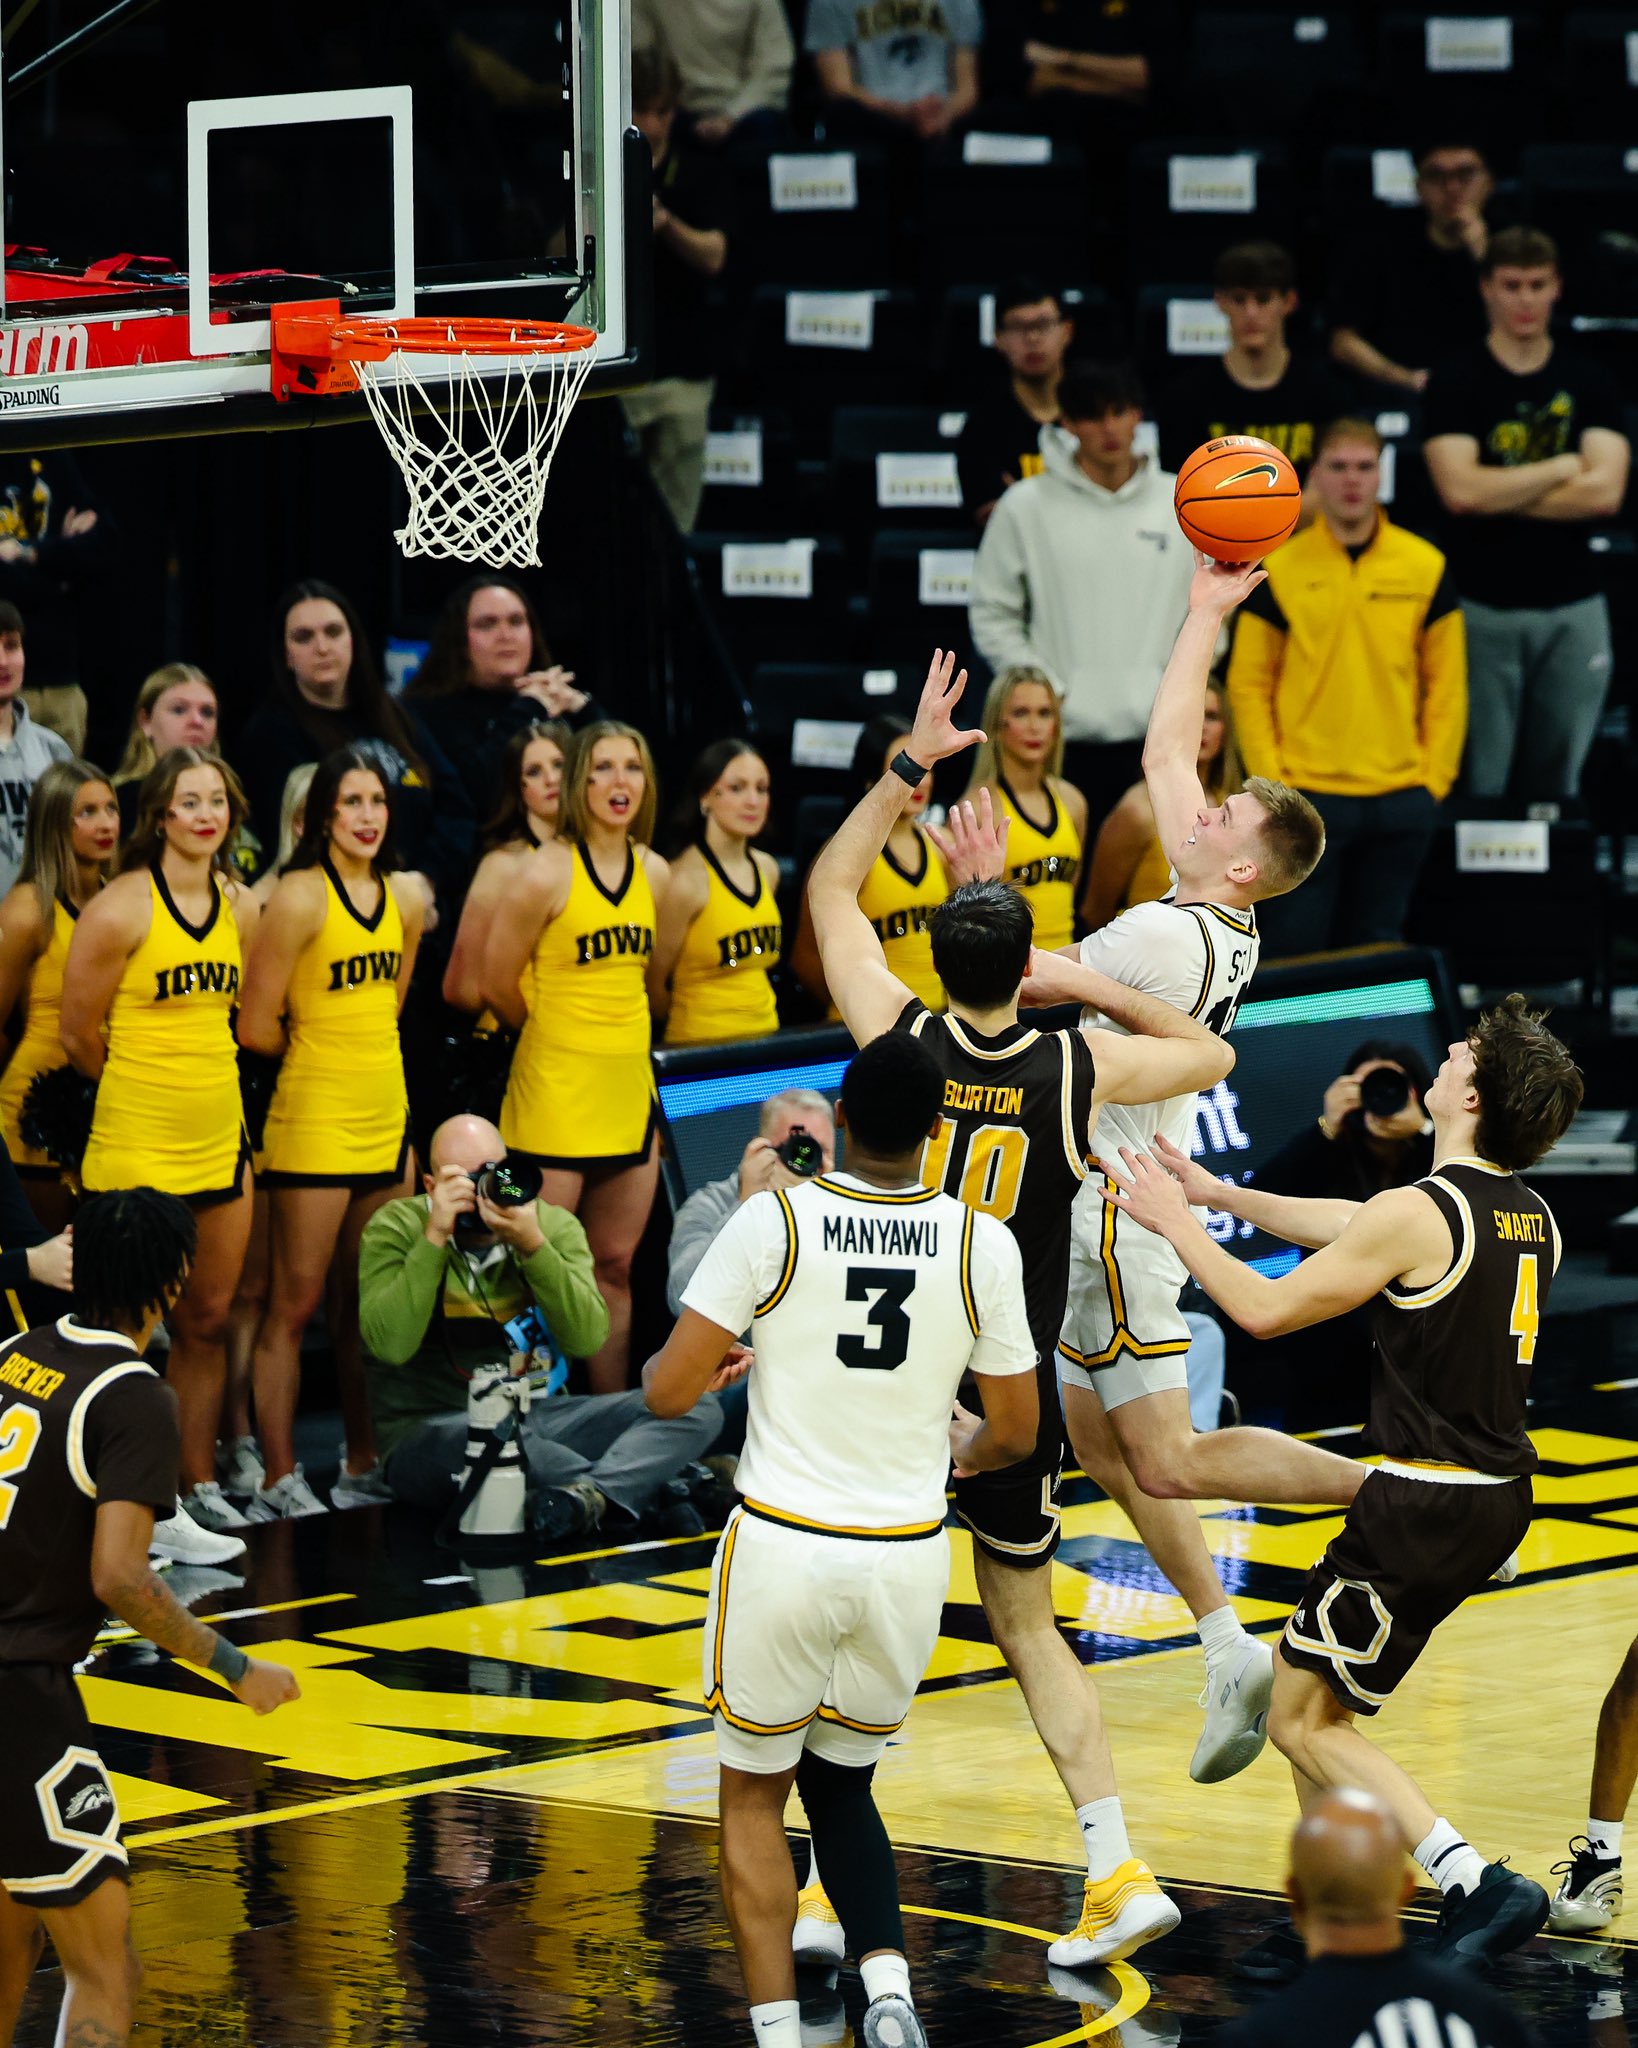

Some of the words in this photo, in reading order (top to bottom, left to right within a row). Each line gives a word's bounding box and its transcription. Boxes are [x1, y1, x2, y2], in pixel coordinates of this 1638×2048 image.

[0, 384, 60, 410] PALDING
[718, 924, 781, 967] IOW
[154, 961, 238, 1001] IOWA
[943, 1078, 1024, 1116] BURTON
[918, 1116, 1031, 1223] 10
[823, 1215, 938, 1258] MANYAWU
[1493, 1209, 1546, 1243] SWARTZ
[836, 1267, 916, 1371] 3
[1509, 1253, 1540, 1366] 4
[0, 1351, 66, 1401] BREWER
